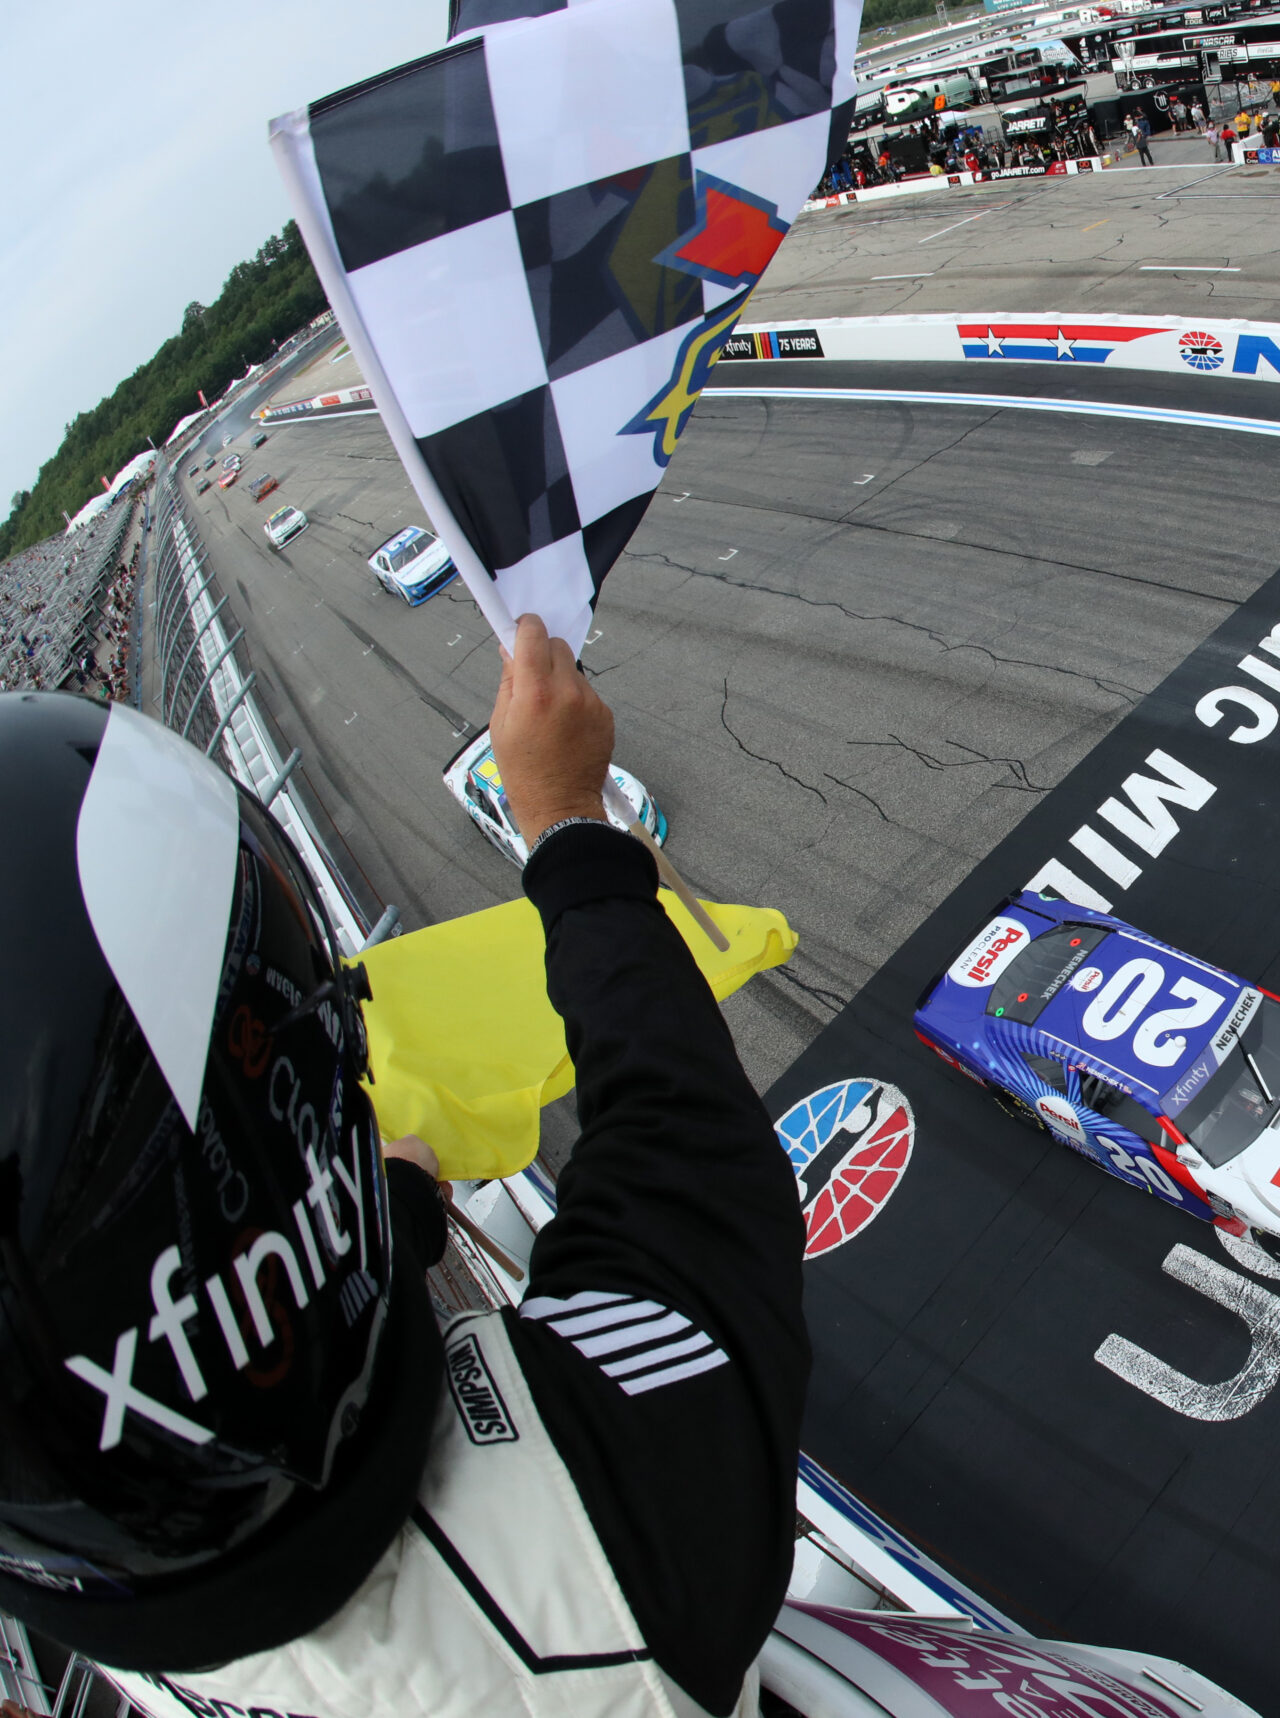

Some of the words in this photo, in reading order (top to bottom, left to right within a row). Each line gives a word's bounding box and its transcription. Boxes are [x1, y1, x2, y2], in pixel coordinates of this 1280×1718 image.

[1202, 36, 1236, 47] NASCAR
[1007, 117, 1046, 132] JARRETT
[990, 166, 1046, 181] goJARRETT.com
[724, 339, 752, 355] xfinity
[779, 339, 790, 351] 75
[790, 338, 816, 350] YEARS
[1020, 748, 1217, 914] MIL
[960, 926, 1001, 970] PROCLEAN
[967, 927, 1024, 983] Persil
[1040, 949, 1089, 1000] NEMECHEK
[1082, 971, 1100, 991] Persil
[1083, 957, 1226, 1067] 20
[1215, 992, 1257, 1052] NEMECHEK
[1171, 1061, 1211, 1107] xfinity
[1039, 1102, 1081, 1131] Persil
[1096, 1135, 1184, 1201] 20
[64, 1125, 367, 1451] xfinity
[449, 1343, 507, 1435] SIMPSON
